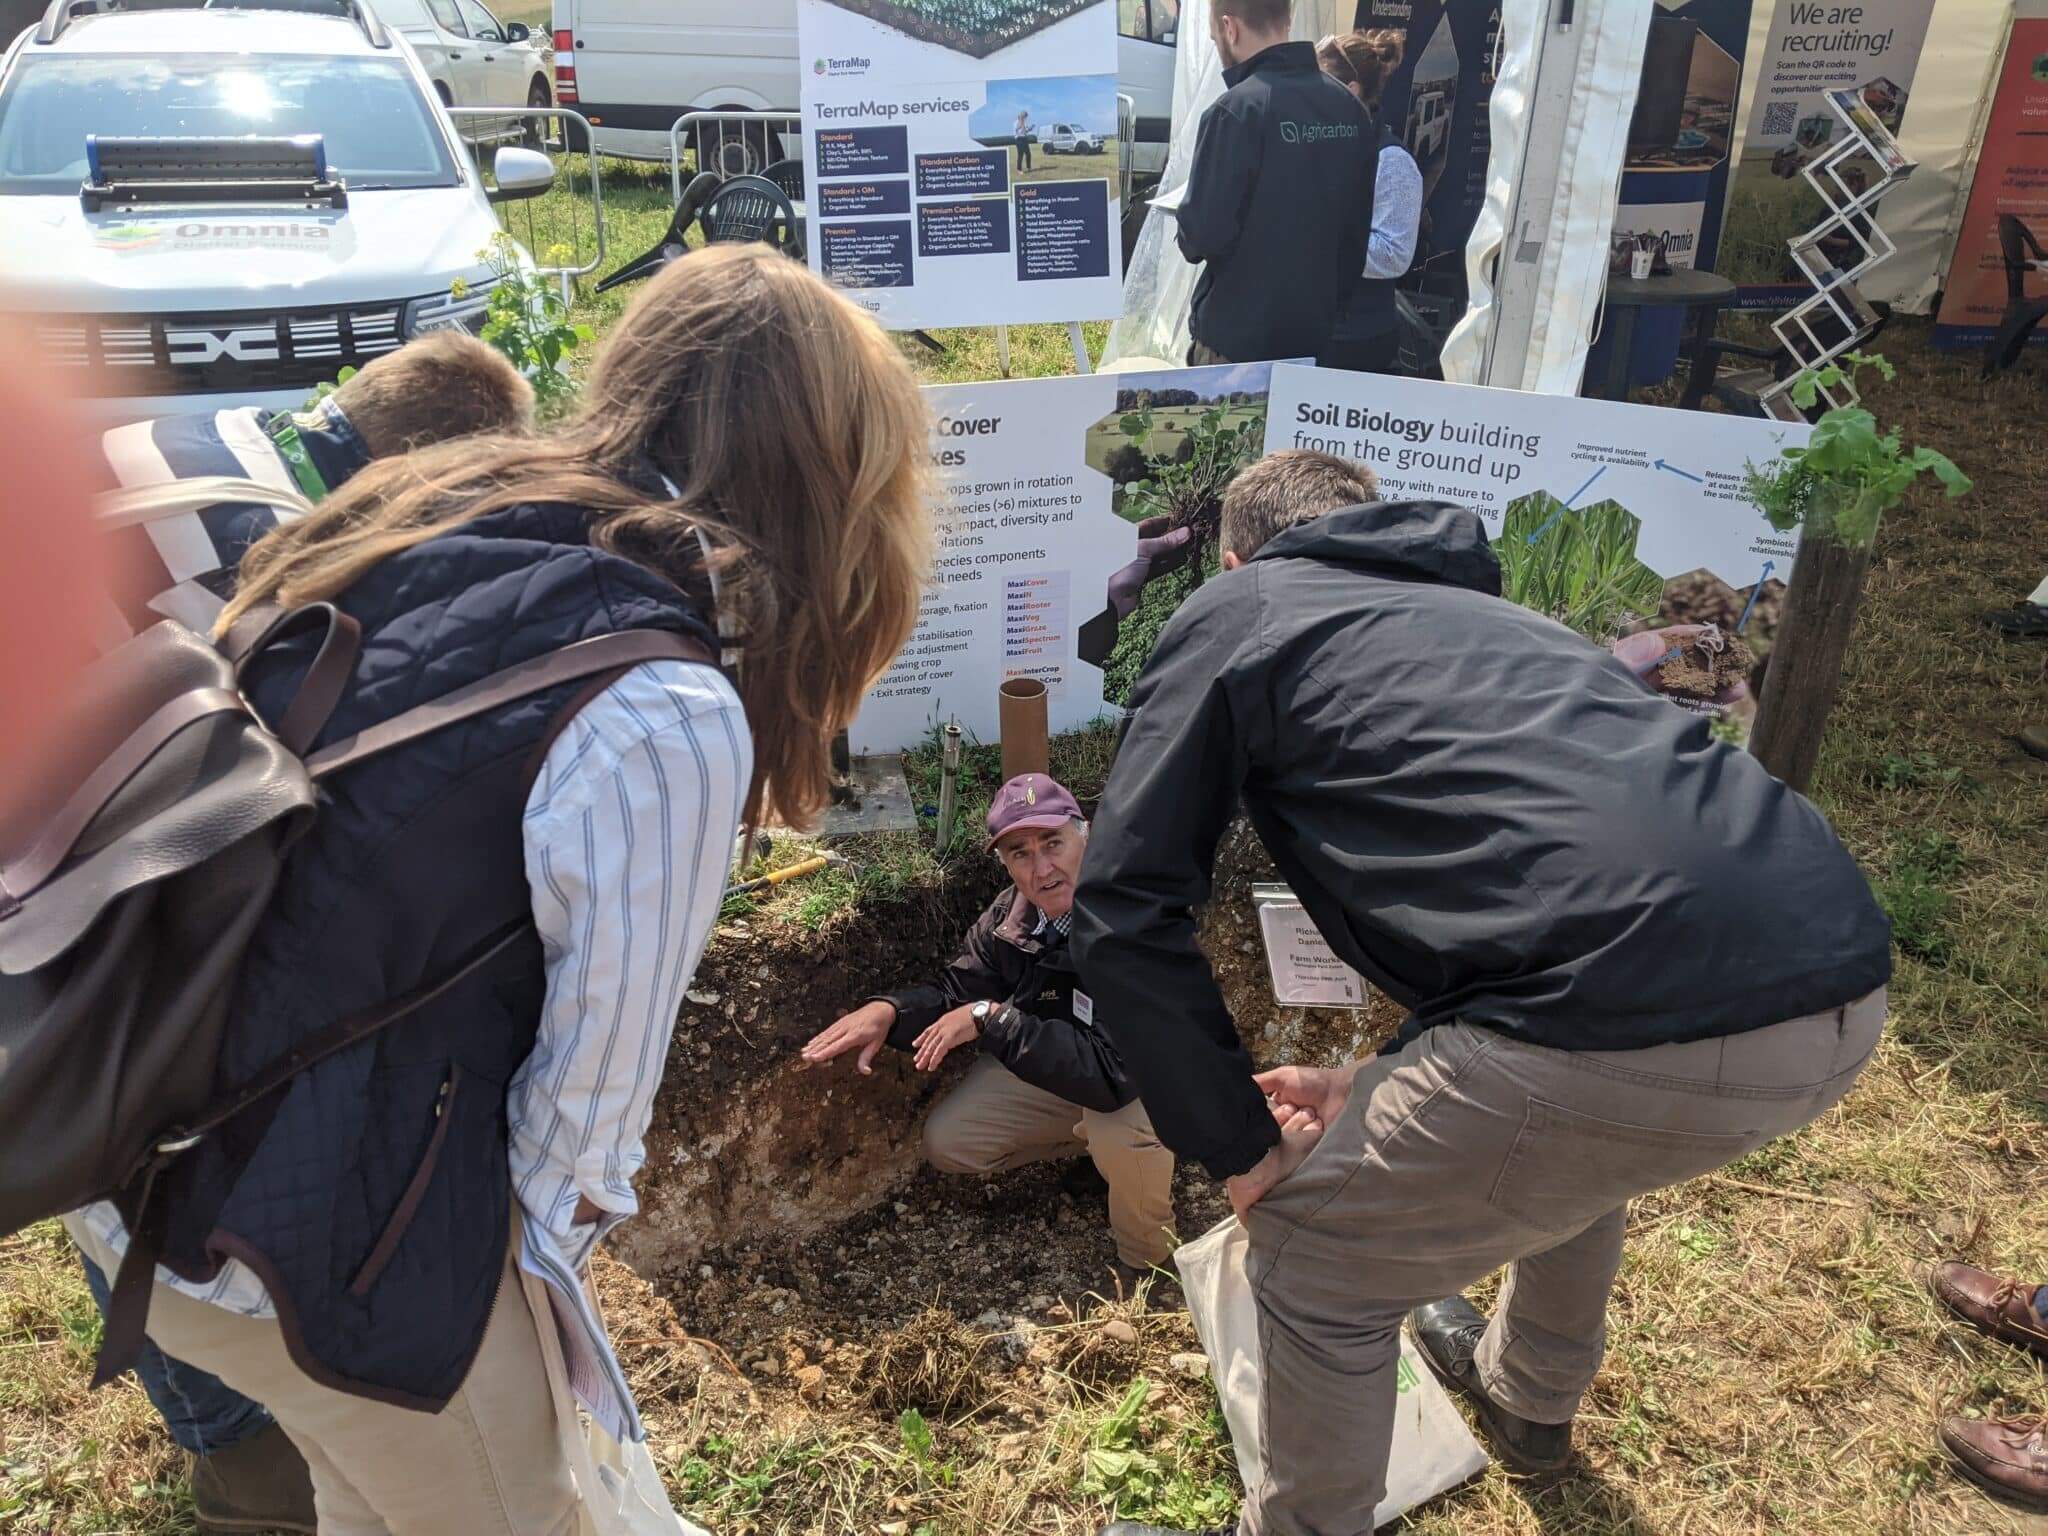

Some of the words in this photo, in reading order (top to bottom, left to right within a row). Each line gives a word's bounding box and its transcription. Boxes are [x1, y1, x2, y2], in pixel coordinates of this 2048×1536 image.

[1789, 2, 1823, 25] We
[1828, 6, 1863, 25] are
[1782, 28, 1894, 56] recruiting!
[827, 56, 871, 69] TerraMap
[1776, 59, 1797, 70] Scan
[1797, 59, 1811, 70] the
[1812, 60, 1825, 71] QR
[1826, 60, 1847, 70] code
[1847, 60, 1857, 69] to
[1773, 72, 1808, 82] discover
[1808, 73, 1823, 82] our
[1824, 71, 1857, 83] exciting
[1770, 84, 1825, 95] opportunitie
[814, 100, 899, 119] TerraMap
[902, 97, 970, 114] services
[820, 133, 853, 142] Standard
[1302, 121, 1359, 144] Agricarbon
[920, 158, 953, 166] Standard
[953, 156, 980, 165] Carbon
[823, 187, 856, 195] Standard
[861, 186, 876, 194] OM
[1020, 188, 1037, 197] Gold
[922, 207, 954, 215] Premium
[953, 205, 981, 213] Carbon
[175, 223, 329, 238] Omnia
[824, 228, 856, 236] Premium
[1661, 228, 1694, 253] Omnia
[937, 416, 1002, 437] Cover
[1296, 402, 1340, 428] Soil
[1345, 407, 1435, 444] Biology
[1440, 418, 1542, 459] building
[1577, 442, 1614, 456] Improved
[1615, 447, 1647, 459] nutrient
[1293, 430, 1346, 457] from
[1353, 438, 1391, 463] the
[1396, 448, 1483, 475] ground
[1490, 460, 1521, 485] up
[1570, 451, 1598, 463] cycling
[1598, 454, 1606, 462] &
[1606, 455, 1651, 470] availability
[1704, 470, 1741, 483] Releases
[974, 481, 1010, 496] grown
[1014, 477, 1025, 490] in
[1027, 474, 1074, 489] rotation
[1409, 479, 1435, 493] with
[1438, 485, 1479, 499] nature
[1481, 489, 1495, 502] to
[1707, 480, 1717, 489] at
[1718, 482, 1738, 492] each
[1703, 489, 1718, 499] the
[1718, 491, 1734, 501] soil
[993, 497, 1015, 513] (>6)
[1018, 494, 1067, 510] mixtures
[1070, 494, 1082, 505] to
[1000, 512, 1049, 528] diversity
[1051, 510, 1074, 522] and
[1755, 536, 1796, 549] Symbiotic
[975, 548, 1046, 564] components
[948, 569, 983, 582] needs
[1007, 578, 1048, 589] MaxiCover
[923, 592, 940, 602] mix
[1007, 590, 1033, 600] MaxiN
[953, 601, 988, 612] fixation
[1007, 601, 1052, 611] MaxiRooter
[1007, 614, 1040, 624] MaxiVeg
[917, 628, 973, 642] stabilisation
[1006, 624, 1047, 634] MaxiGraze
[1006, 634, 1061, 646] MaxiSpectrum
[916, 641, 969, 656] adjustment
[1006, 646, 1043, 657] MaxiFruit
[921, 657, 942, 668] crop
[917, 670, 929, 681] of
[929, 670, 954, 679] cover
[1006, 665, 1060, 677] MaxiInterCrop
[877, 689, 893, 698] Exit
[895, 685, 932, 697] strategy
[1679, 697, 1700, 706] roots
